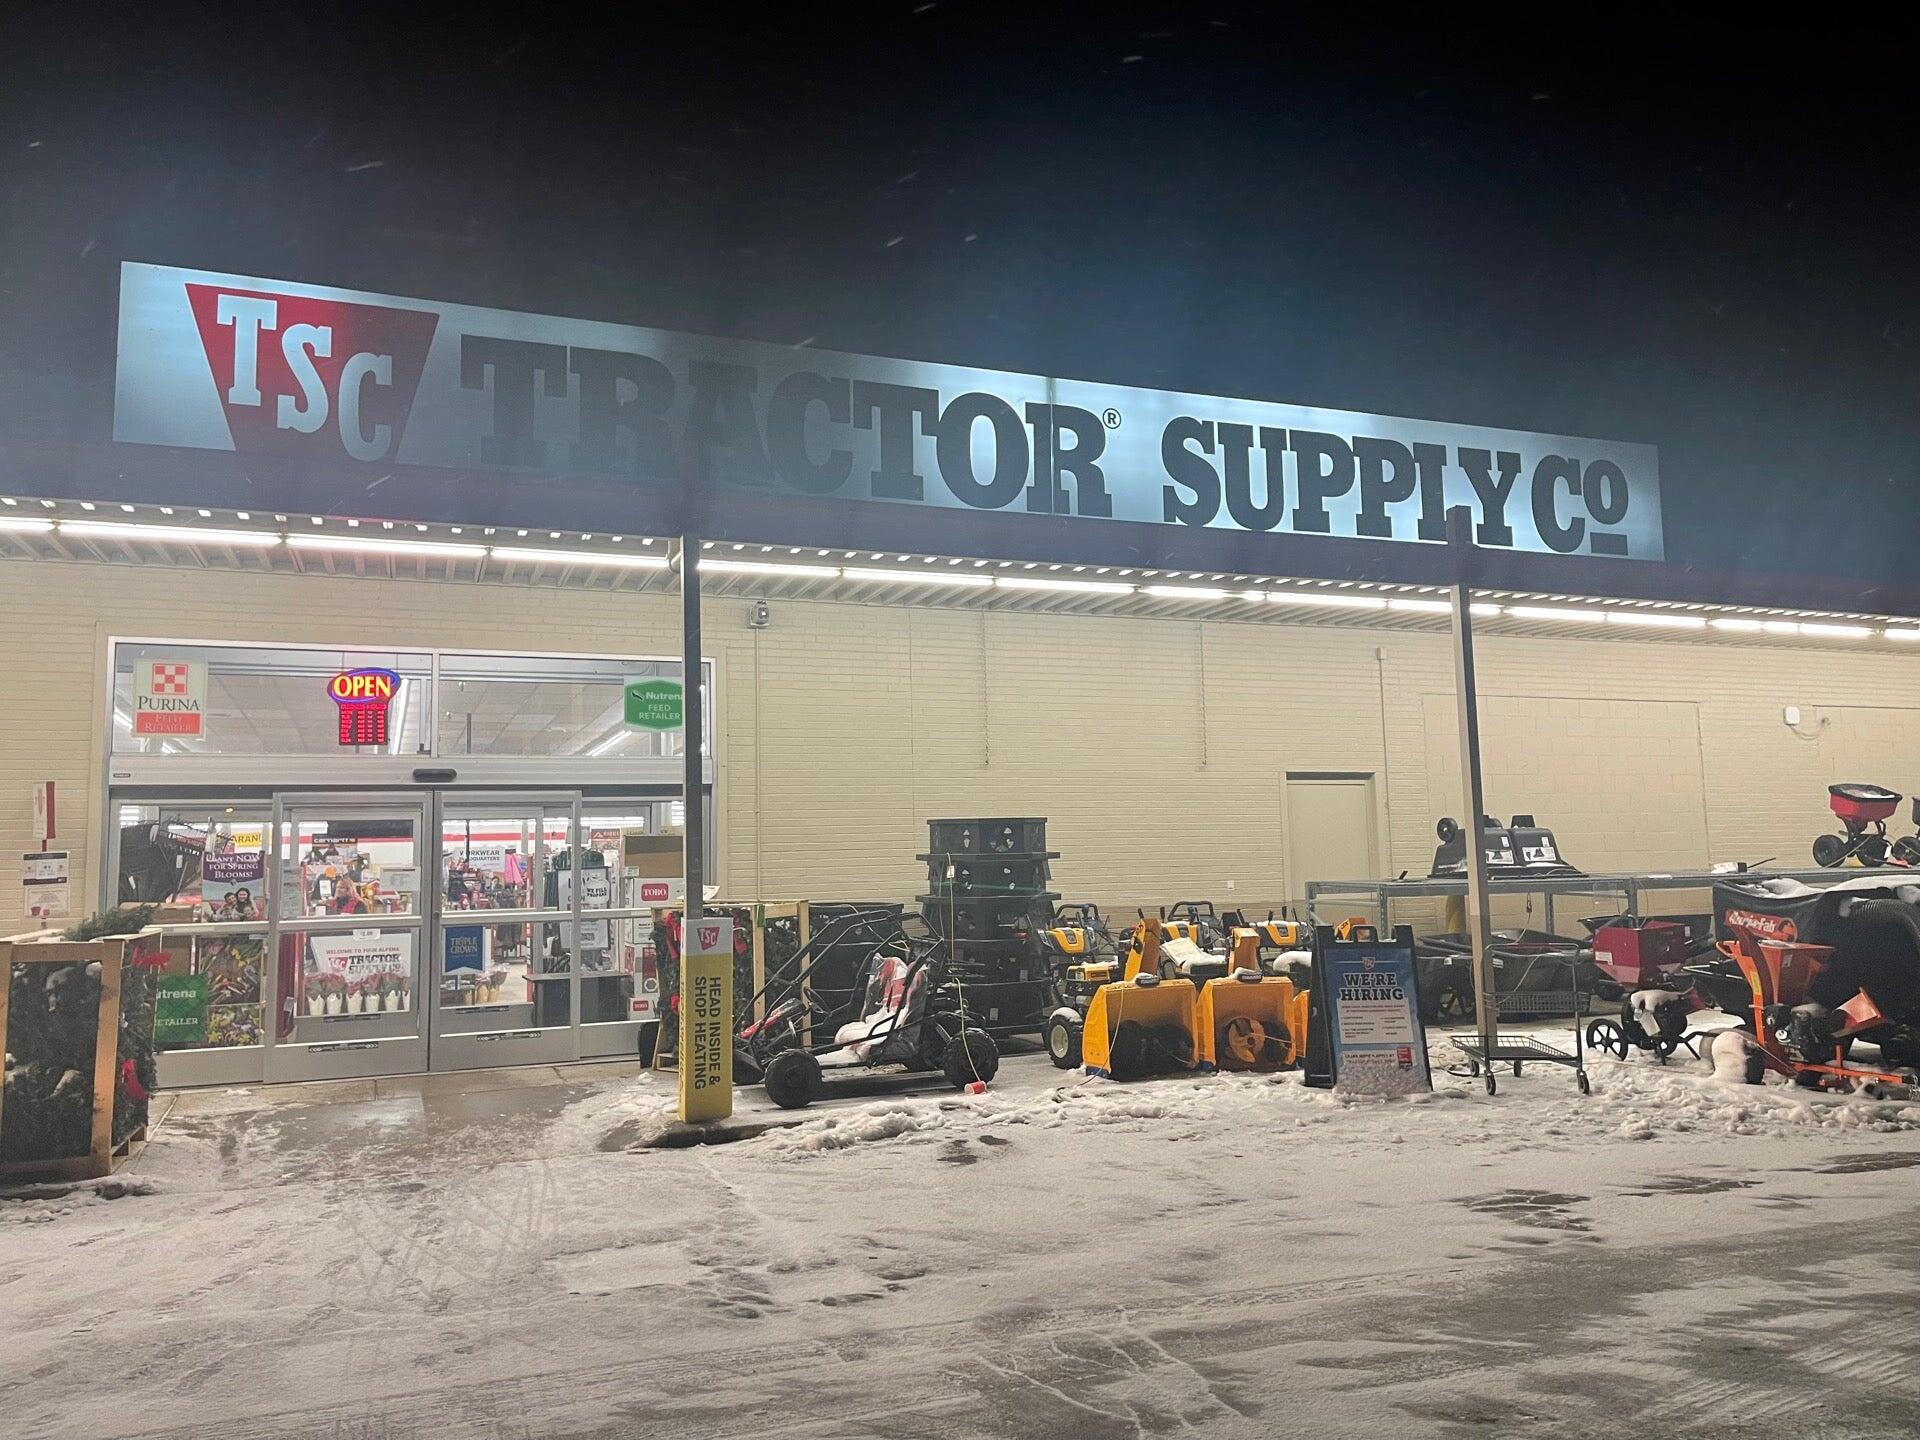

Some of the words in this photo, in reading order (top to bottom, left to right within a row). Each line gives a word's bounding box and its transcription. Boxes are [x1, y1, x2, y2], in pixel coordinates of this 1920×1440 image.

[216, 293, 393, 463] TSC
[460, 334, 1113, 517] TRACTOR
[1160, 415, 1521, 546] SUPPLY
[333, 675, 391, 697] OPEN
[646, 692, 682, 700] Nutren
[138, 695, 201, 711] PURINA
[649, 704, 671, 712] FEED
[639, 712, 681, 720] RETAILER
[227, 862, 259, 870] SPRING
[643, 888, 666, 896] TORO
[700, 928, 717, 945] TSC
[349, 953, 402, 965] TRACTOR
[156, 990, 196, 999] utrena
[694, 976, 707, 1018] SHOP
[709, 977, 721, 1017] HEAD
[1340, 988, 1404, 1001] HIRING
[157, 1018, 198, 1026] ETAILER
[709, 1022, 721, 1071] INSIDE
[694, 1023, 706, 1089] HEATING
[709, 1076, 721, 1085] &
